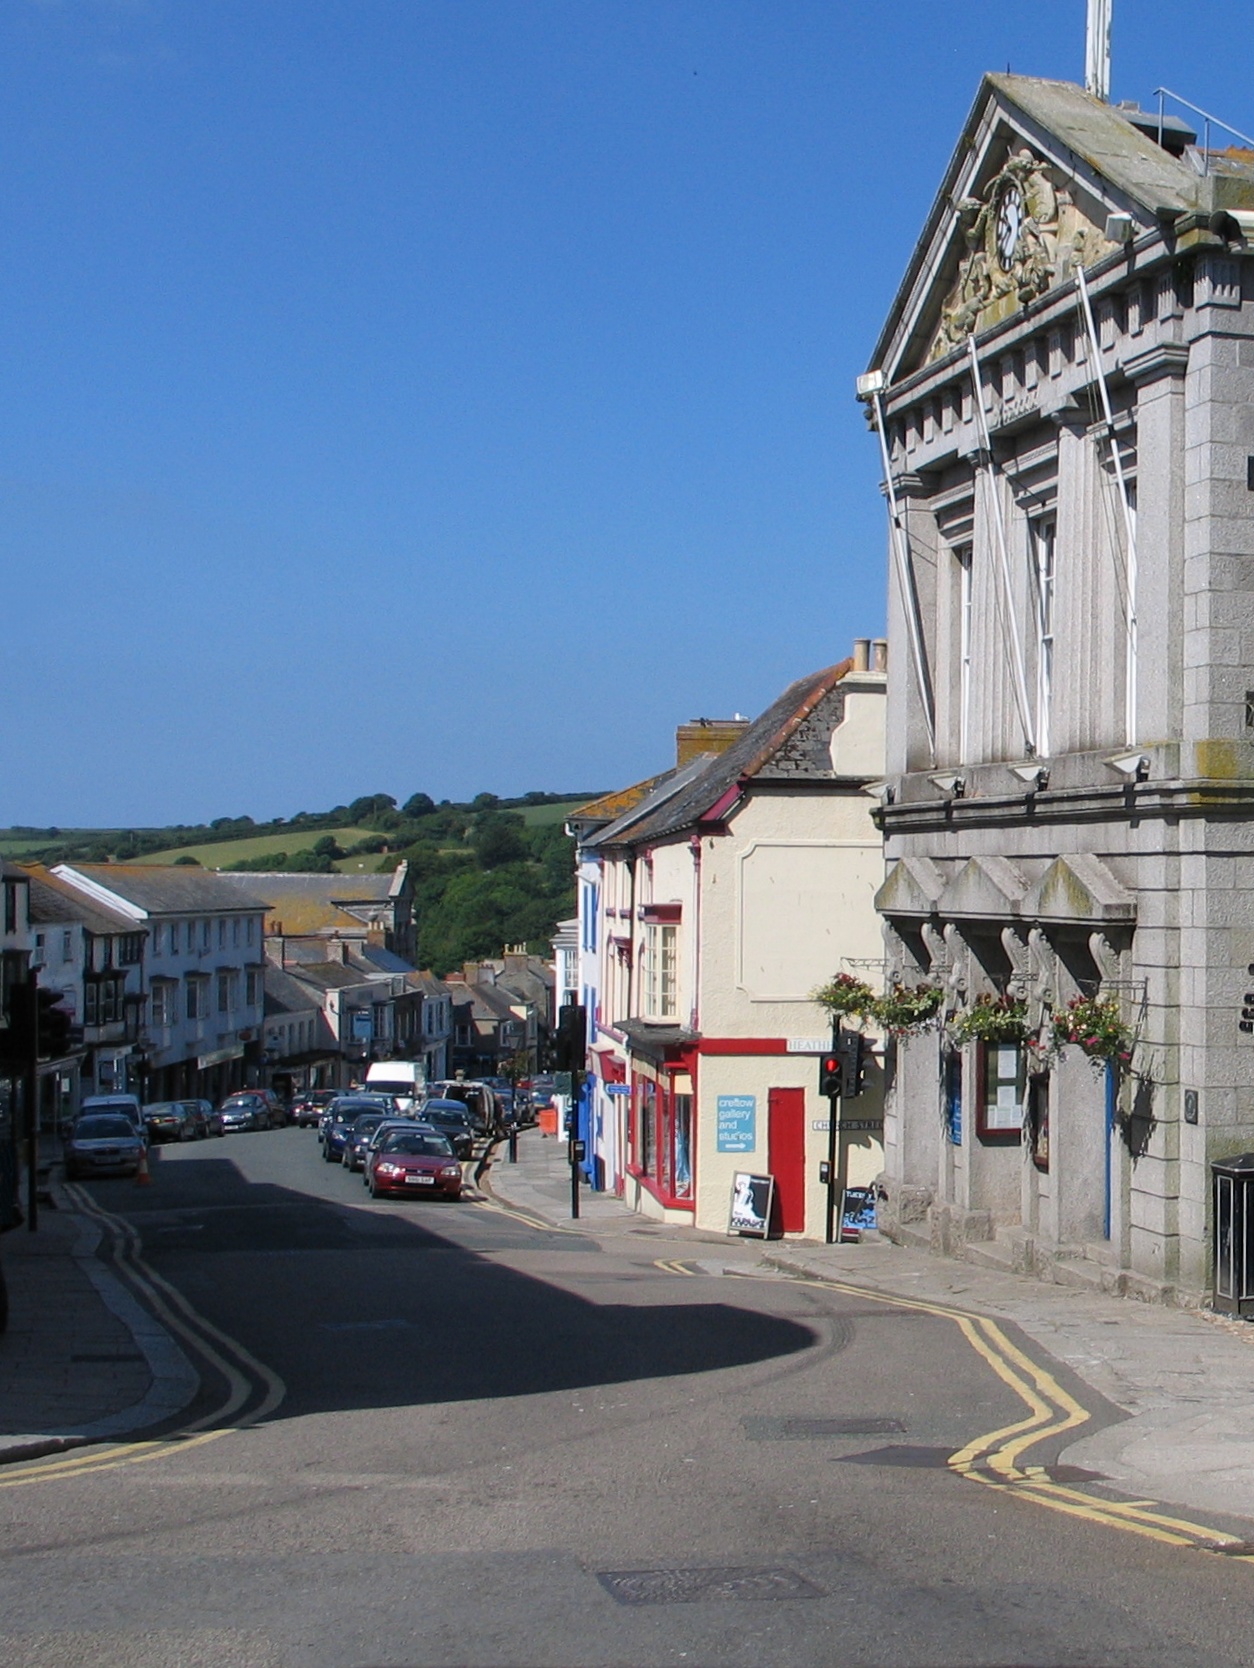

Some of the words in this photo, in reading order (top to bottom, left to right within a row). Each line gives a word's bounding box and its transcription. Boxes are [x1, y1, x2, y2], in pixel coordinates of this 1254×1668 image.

[718, 1108, 751, 1121] gallery
[718, 1120, 738, 1130] and
[718, 1131, 753, 1141] studios
